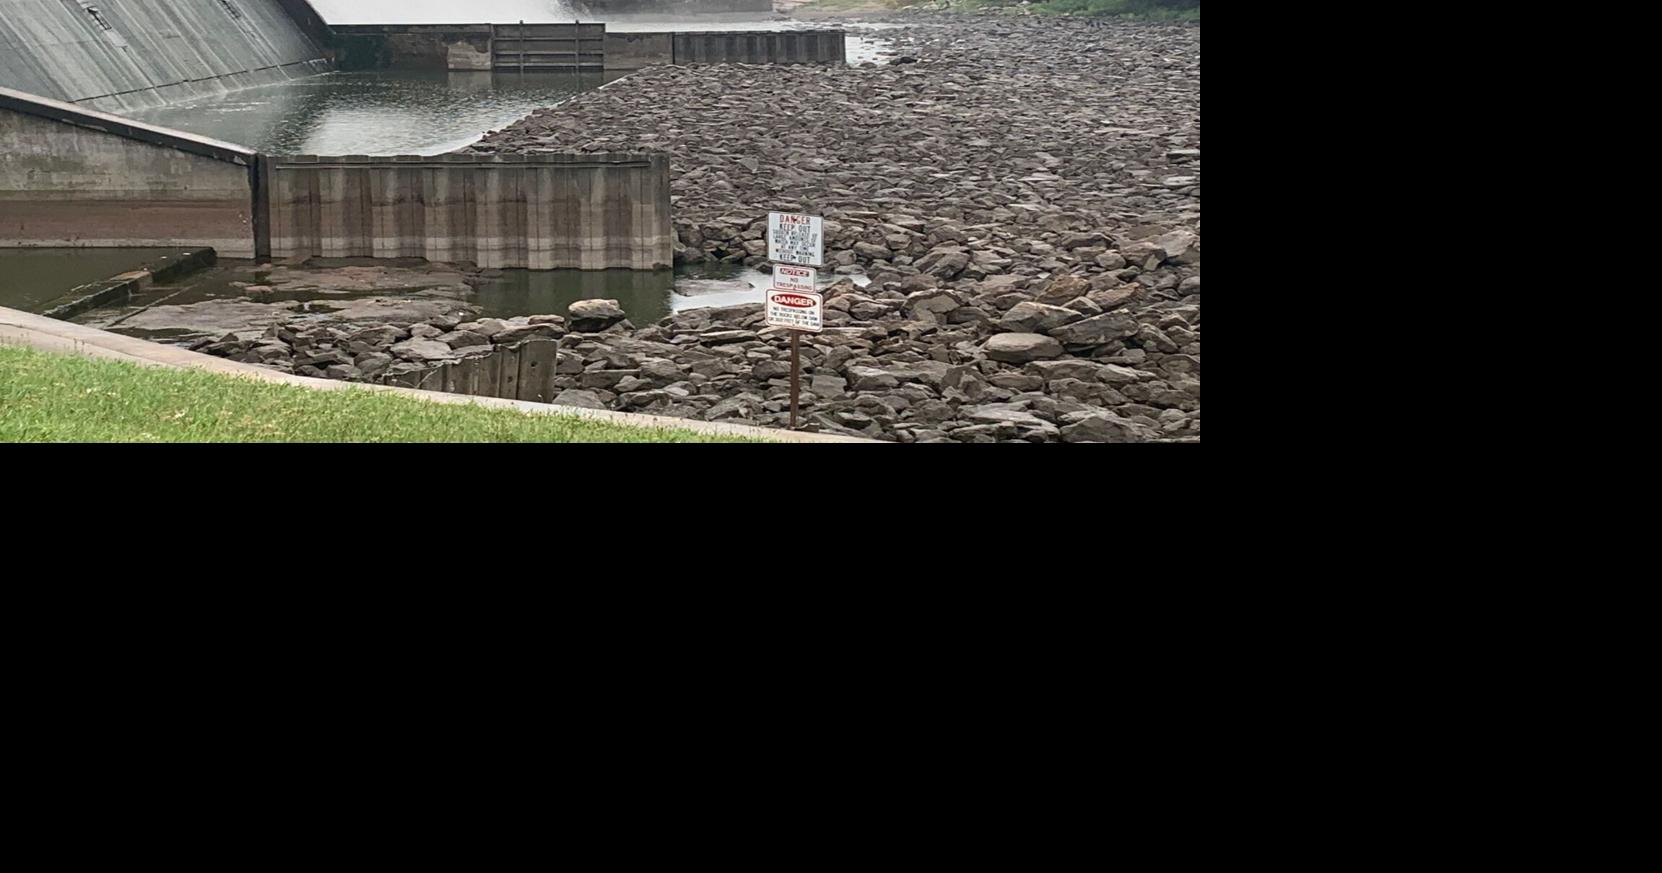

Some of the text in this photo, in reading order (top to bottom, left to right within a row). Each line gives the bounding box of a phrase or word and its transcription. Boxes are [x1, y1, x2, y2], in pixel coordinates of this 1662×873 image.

[780, 215, 810, 224] DANGER
[780, 224, 810, 233] KEEP OUT
[781, 268, 808, 276] NOTICE
[776, 282, 812, 290] TRESPASSING
[774, 296, 814, 306] DANGER
